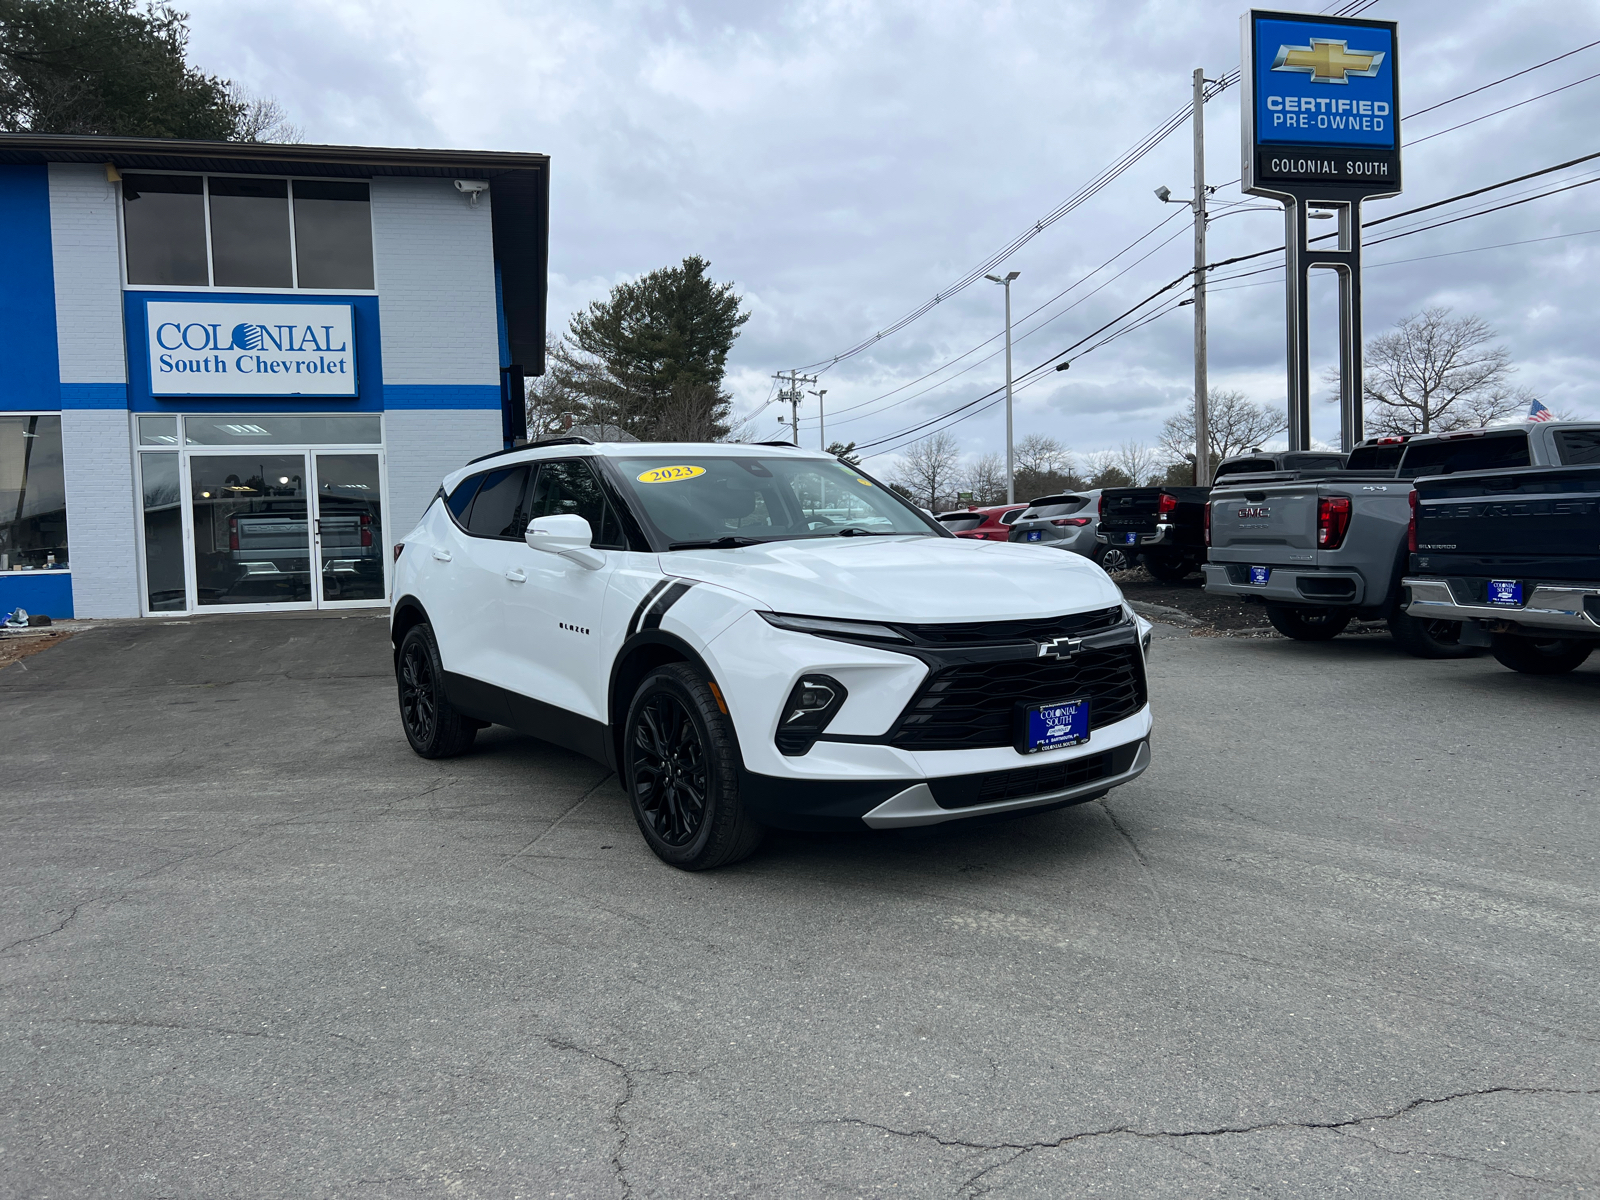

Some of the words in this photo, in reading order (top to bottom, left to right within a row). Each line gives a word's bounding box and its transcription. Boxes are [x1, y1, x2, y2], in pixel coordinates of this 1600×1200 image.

[1267, 95, 1389, 116] CERTIFIED
[1273, 113, 1384, 131] PRE-OWNED
[1271, 158, 1338, 174] COLONIAL
[1346, 161, 1388, 175] SOUTH
[156, 322, 346, 352] COLONIAL
[159, 353, 227, 373] South
[235, 354, 347, 374] Chevrolet
[650, 466, 693, 481] 2023
[1238, 507, 1271, 518] GMC
[559, 622, 590, 635] BLAZER
[1041, 706, 1077, 719] COLONIAL
[1046, 715, 1071, 727] SOUTH
